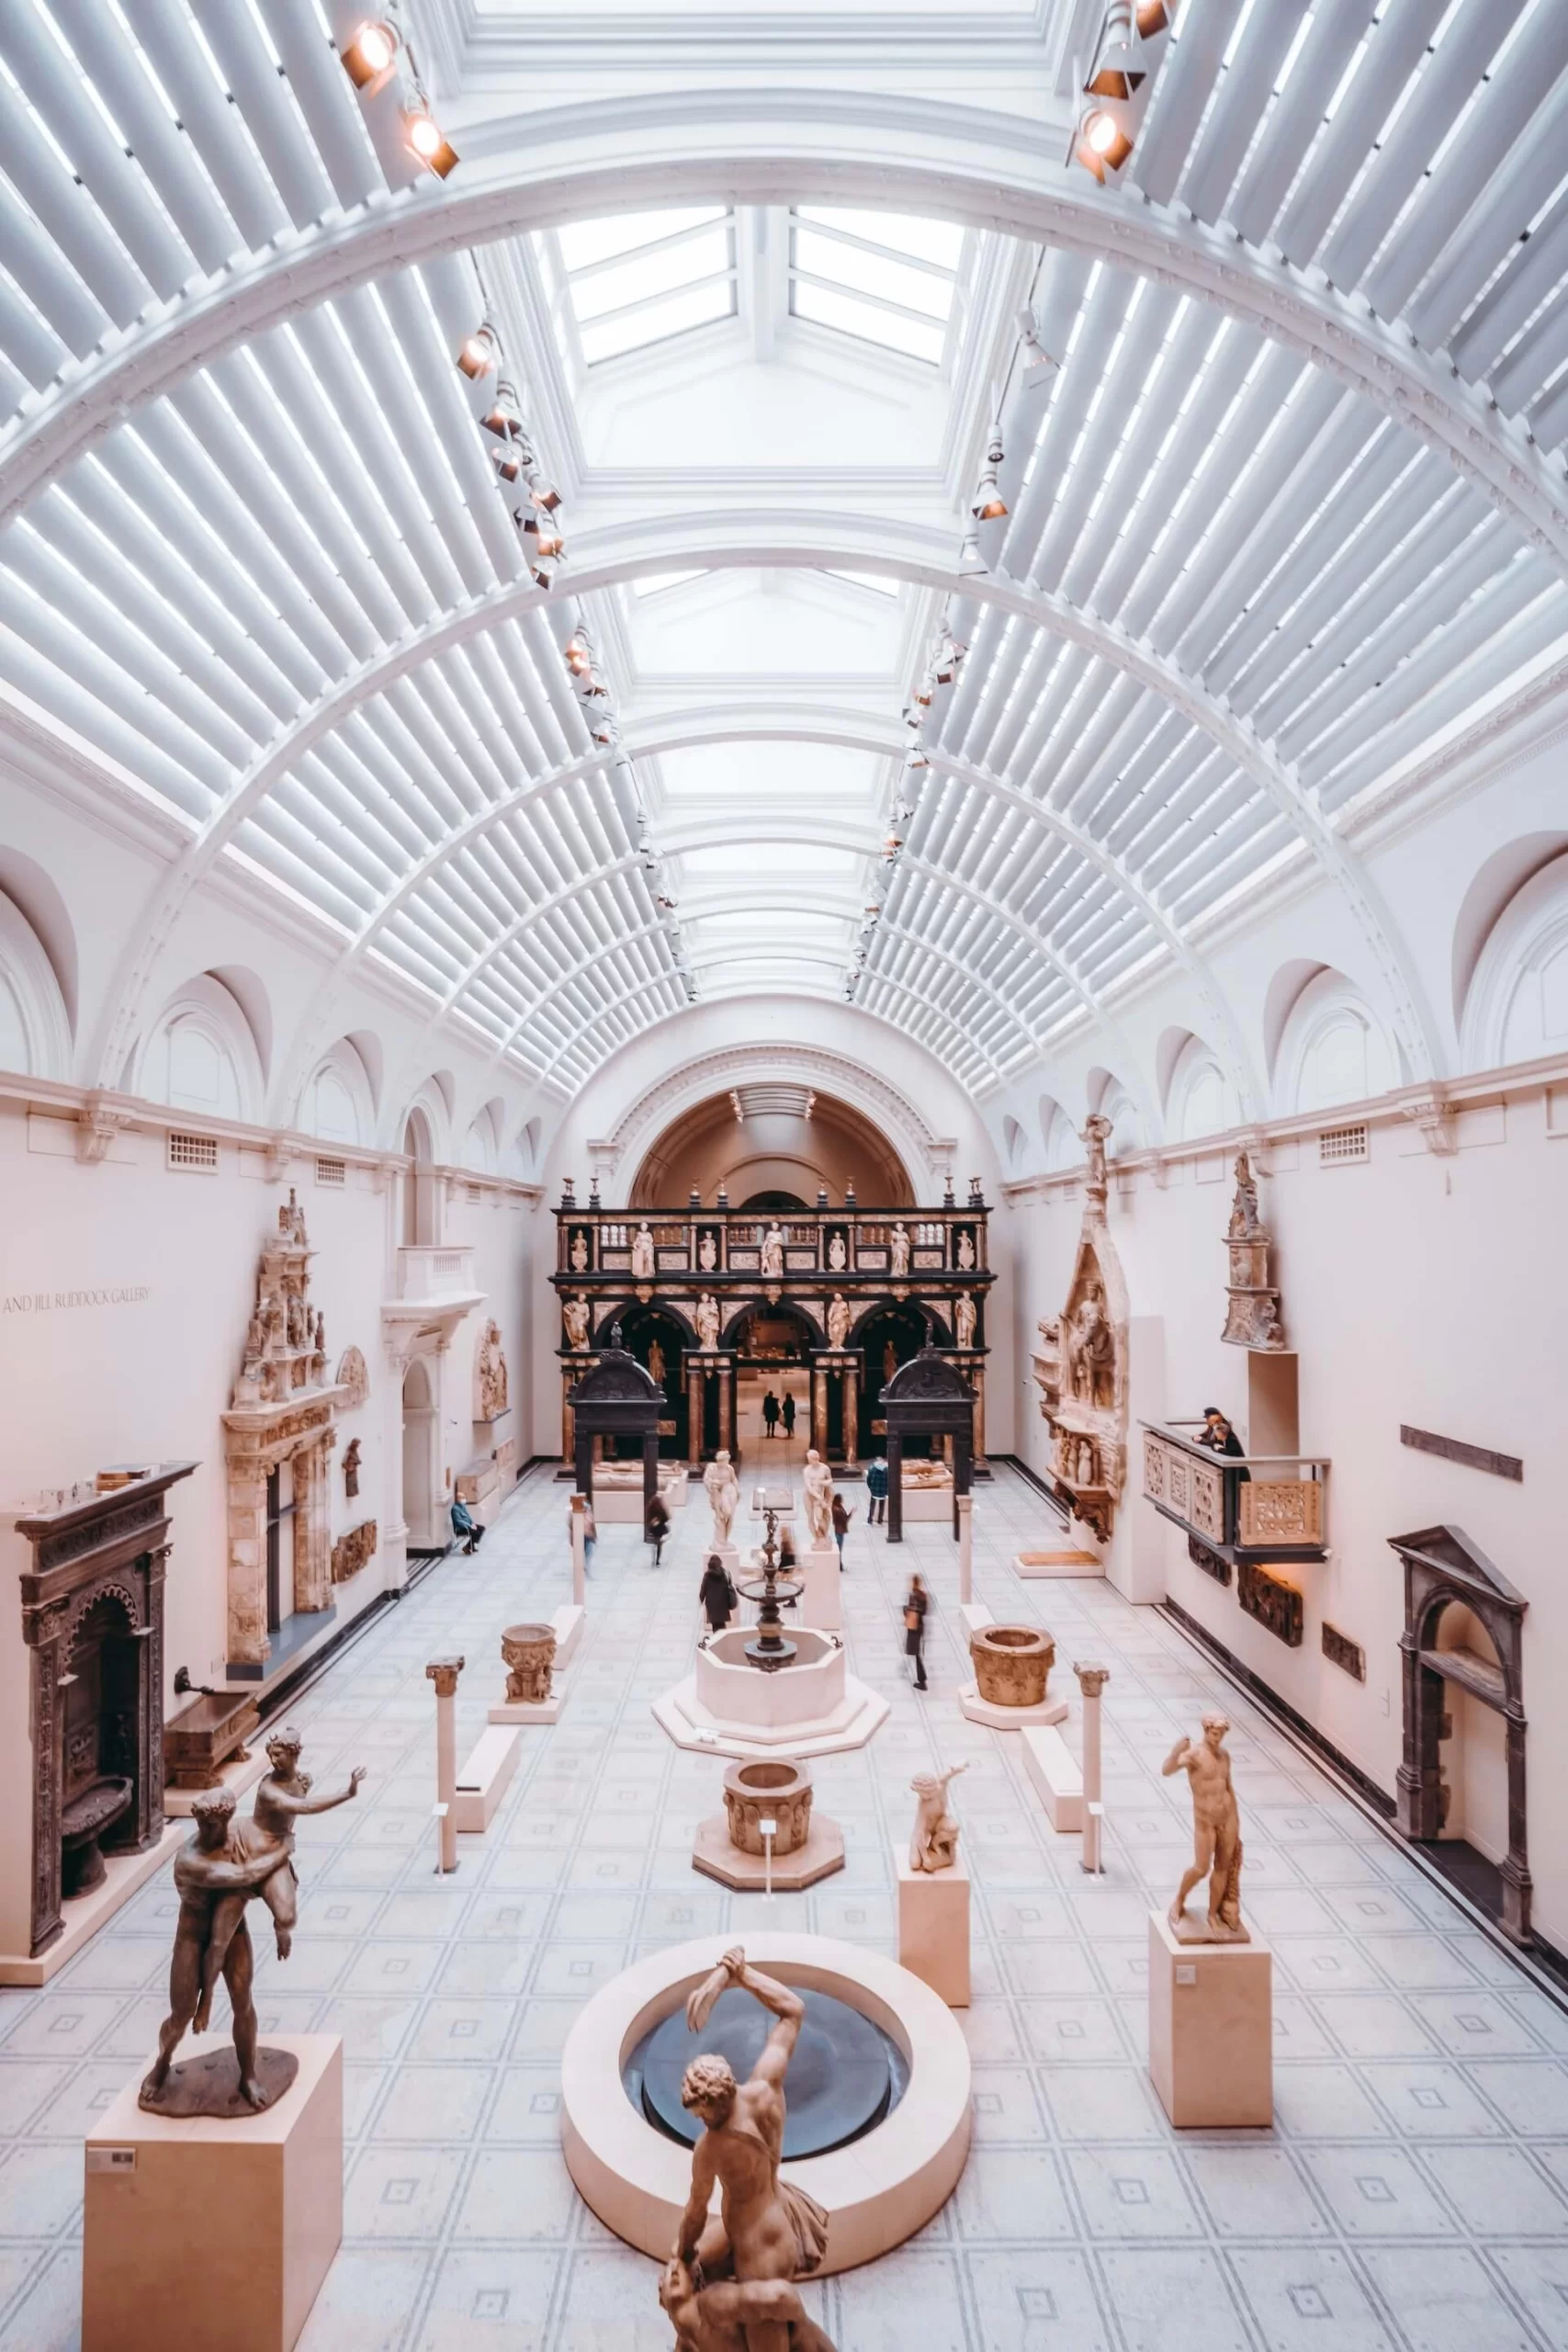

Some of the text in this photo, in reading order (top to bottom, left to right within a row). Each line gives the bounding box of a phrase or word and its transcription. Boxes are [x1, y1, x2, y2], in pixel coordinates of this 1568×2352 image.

[2, 1286, 151, 1315] AND JILL RUDDOCK GALLERY
